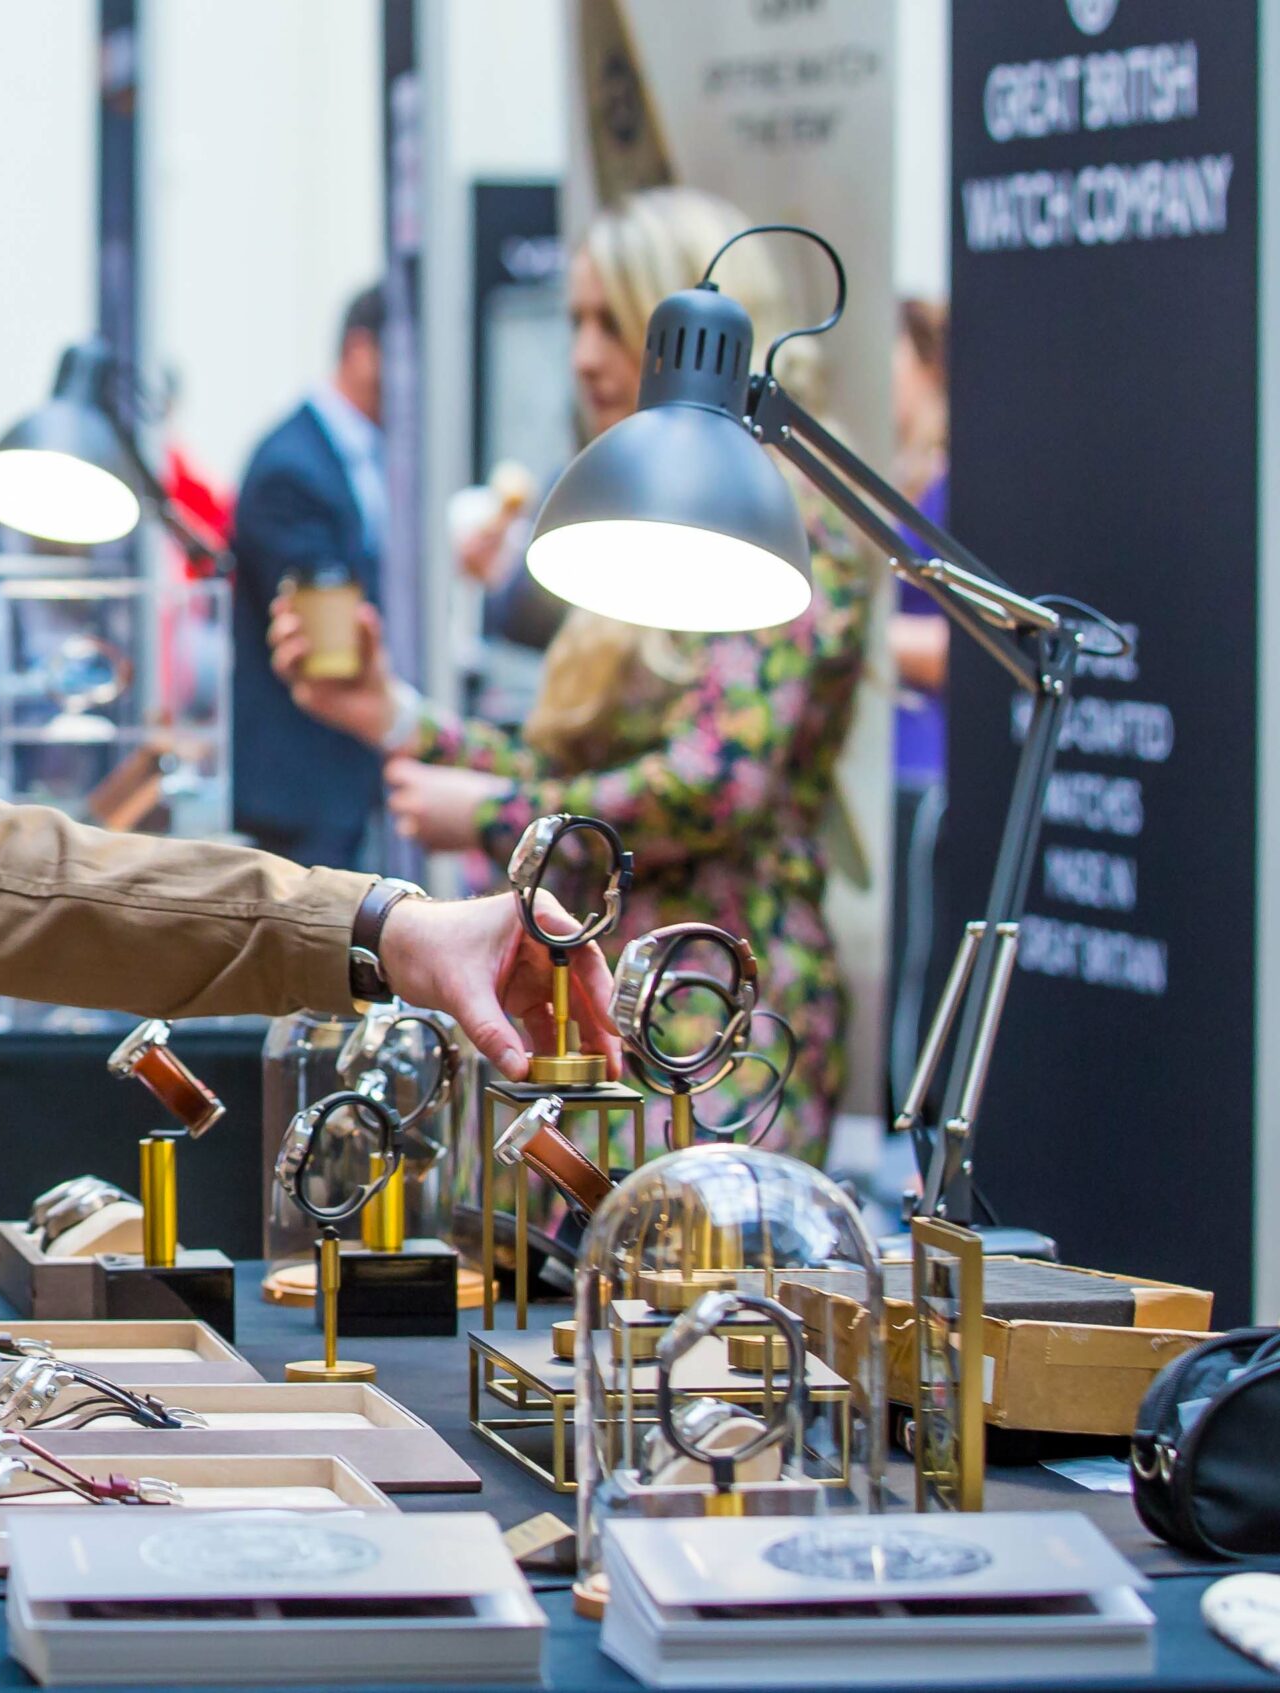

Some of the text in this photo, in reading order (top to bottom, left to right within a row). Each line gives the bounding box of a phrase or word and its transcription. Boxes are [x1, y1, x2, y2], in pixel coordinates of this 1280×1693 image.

[984, 55, 1080, 141] GREAT
[1082, 41, 1197, 131] BRITISH
[962, 154, 1234, 252] WATCH COMPANY
